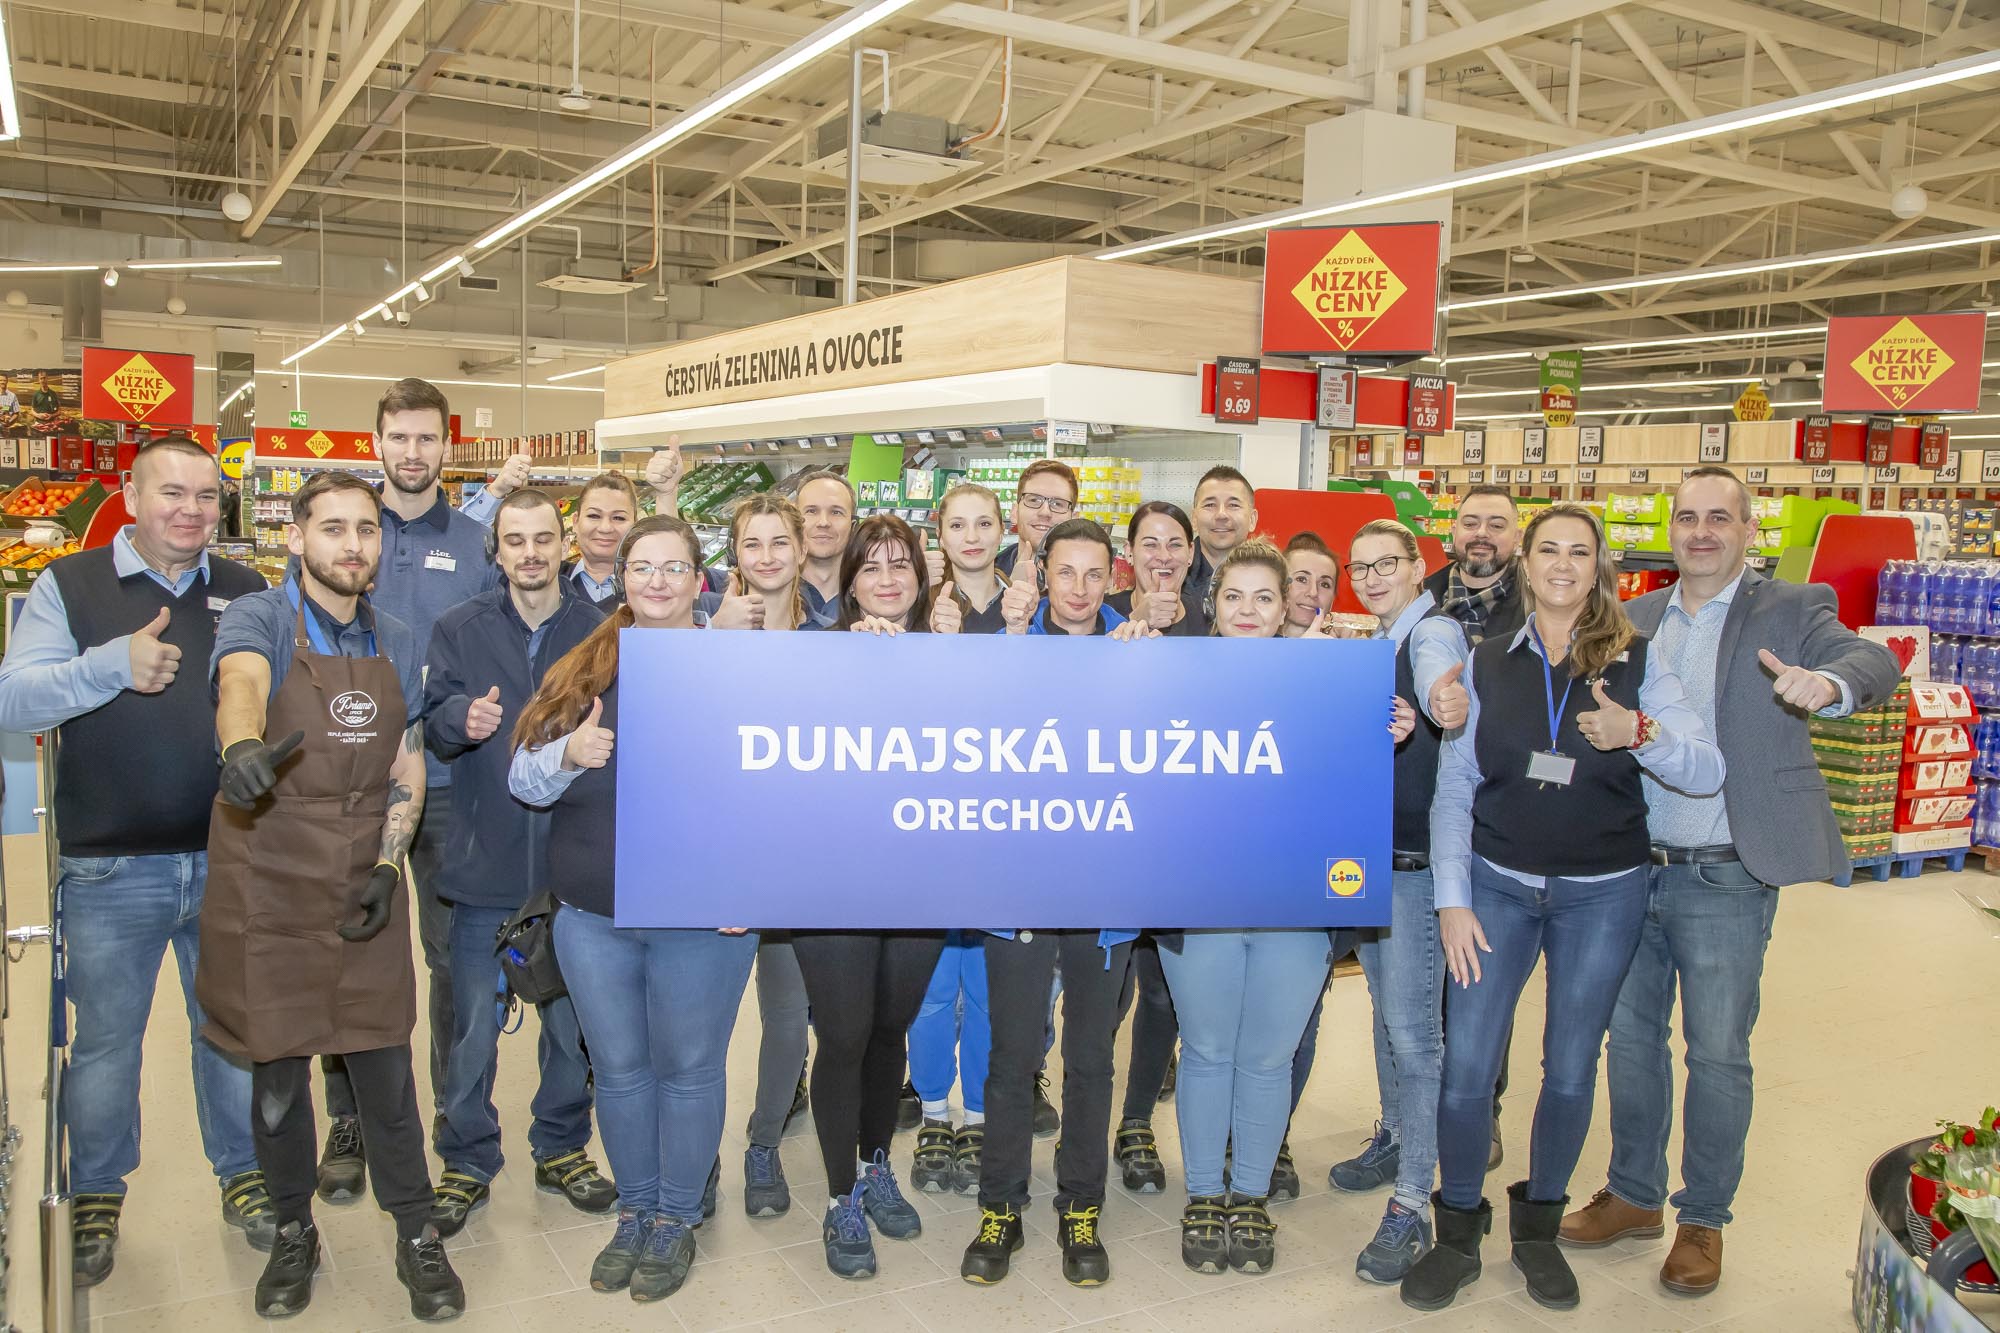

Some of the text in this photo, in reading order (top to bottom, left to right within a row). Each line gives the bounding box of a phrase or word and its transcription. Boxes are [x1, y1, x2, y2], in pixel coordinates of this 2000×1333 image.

[1326, 256, 1374, 265] KAŽDÝ DEŇ
[1311, 267, 1388, 291] NÍZKE
[1315, 292, 1382, 313] CENY
[665, 324, 903, 397] ČERSTVÁ ZELENINA A OVOCIE
[1868, 346, 1938, 365] NÍZKE
[1228, 360, 1250, 369] ČASOVO
[1872, 365, 1932, 381] CENY
[114, 373, 164, 389] NÍZKE
[1414, 377, 1443, 390] AKCIA
[118, 388, 160, 401] CENY
[1224, 397, 1251, 414] 9.69
[1739, 397, 1768, 411] NÍZKE
[1417, 413, 1438, 427] 0.59
[1547, 413, 1572, 424] ceny
[1808, 416, 1830, 428] AKCIA
[1871, 420, 1892, 431] AKCIA
[1925, 424, 1944, 434] AKCIA
[1465, 449, 1481, 459] 0.59
[1525, 447, 1543, 458] 1.48
[1581, 446, 1599, 457] 1.78
[1704, 446, 1721, 457] 1.18
[1809, 447, 1825, 459] 8.99
[2, 456, 15, 464] 1.99
[31, 456, 45, 465] 2.89
[1815, 468, 1832, 478] 1.09
[1878, 467, 1896, 478] 1.69
[1936, 467, 1956, 477] 2.45
[738, 718, 1284, 775] DUNAJSKÁ LUŽNÁ
[892, 792, 1134, 832] ORECHOVÁ
